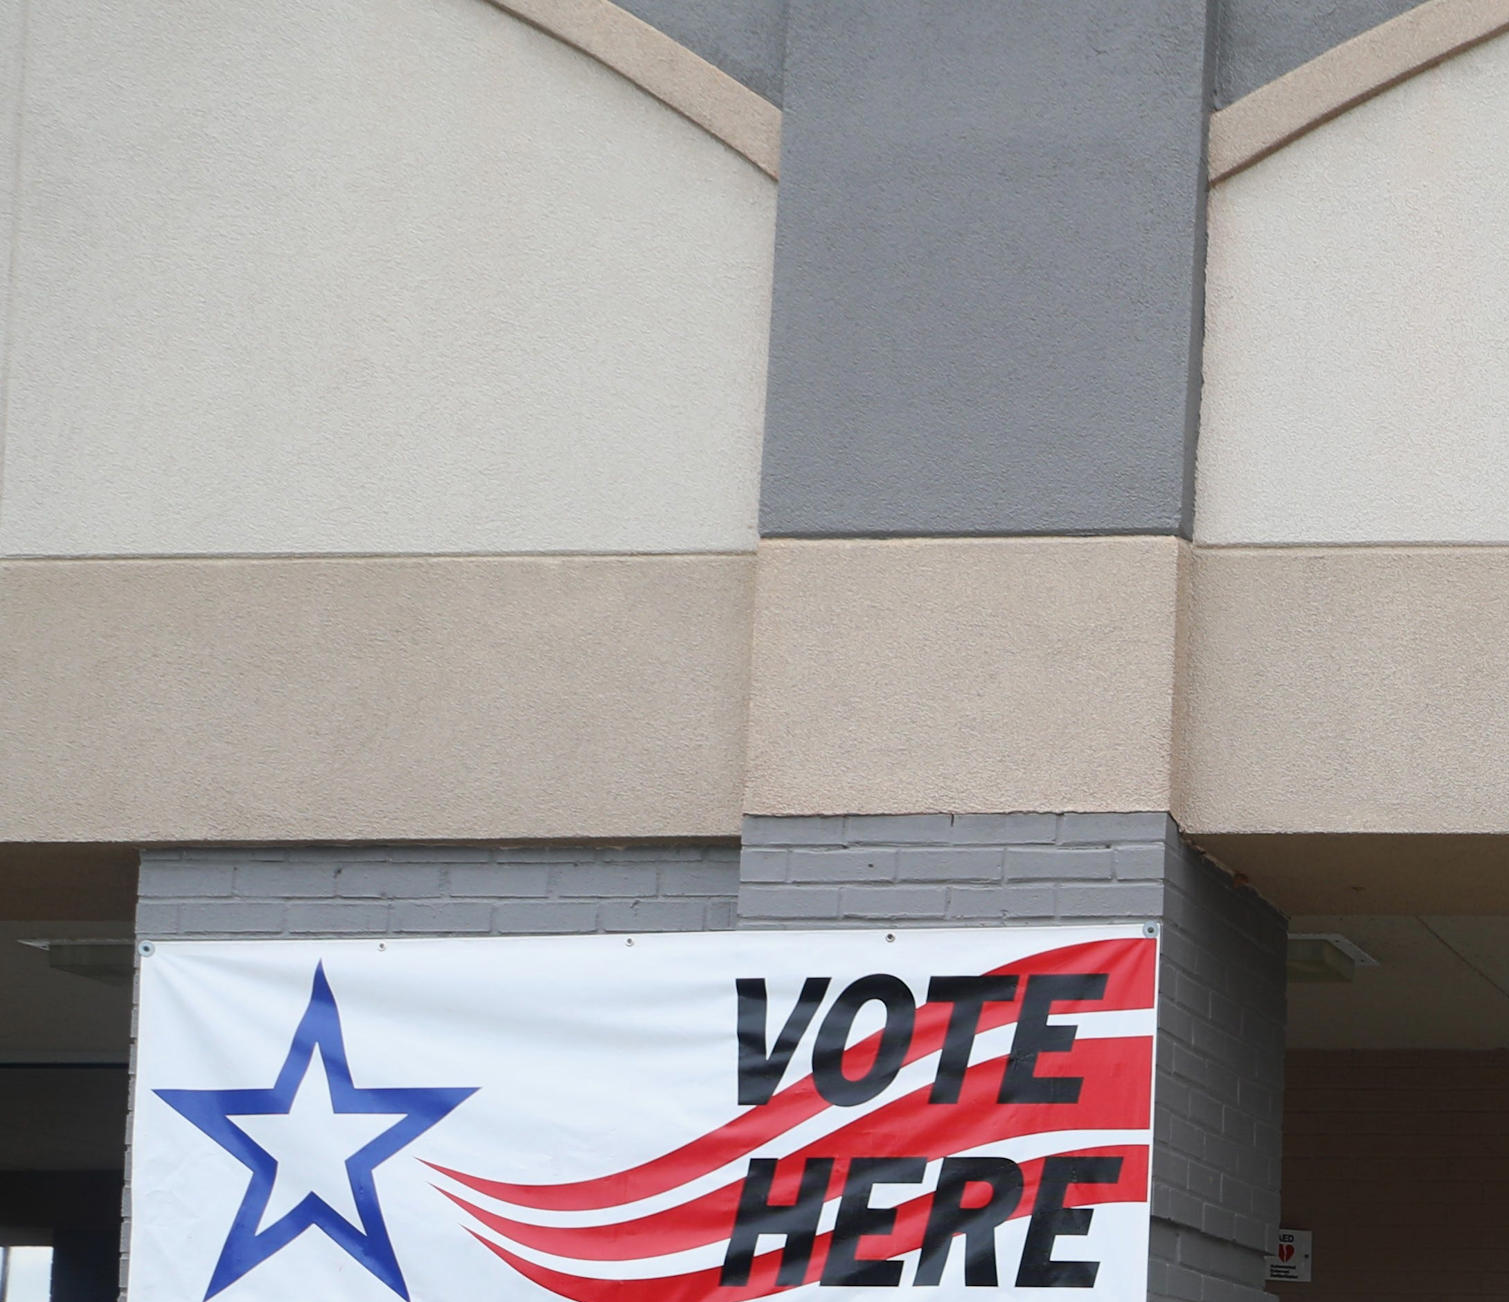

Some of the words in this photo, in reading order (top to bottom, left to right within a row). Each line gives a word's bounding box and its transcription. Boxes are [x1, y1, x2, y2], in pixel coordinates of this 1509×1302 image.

[735, 972, 1109, 1106] VOTE
[717, 1156, 1124, 1290] HERE
[1279, 1233, 1295, 1243] ED
